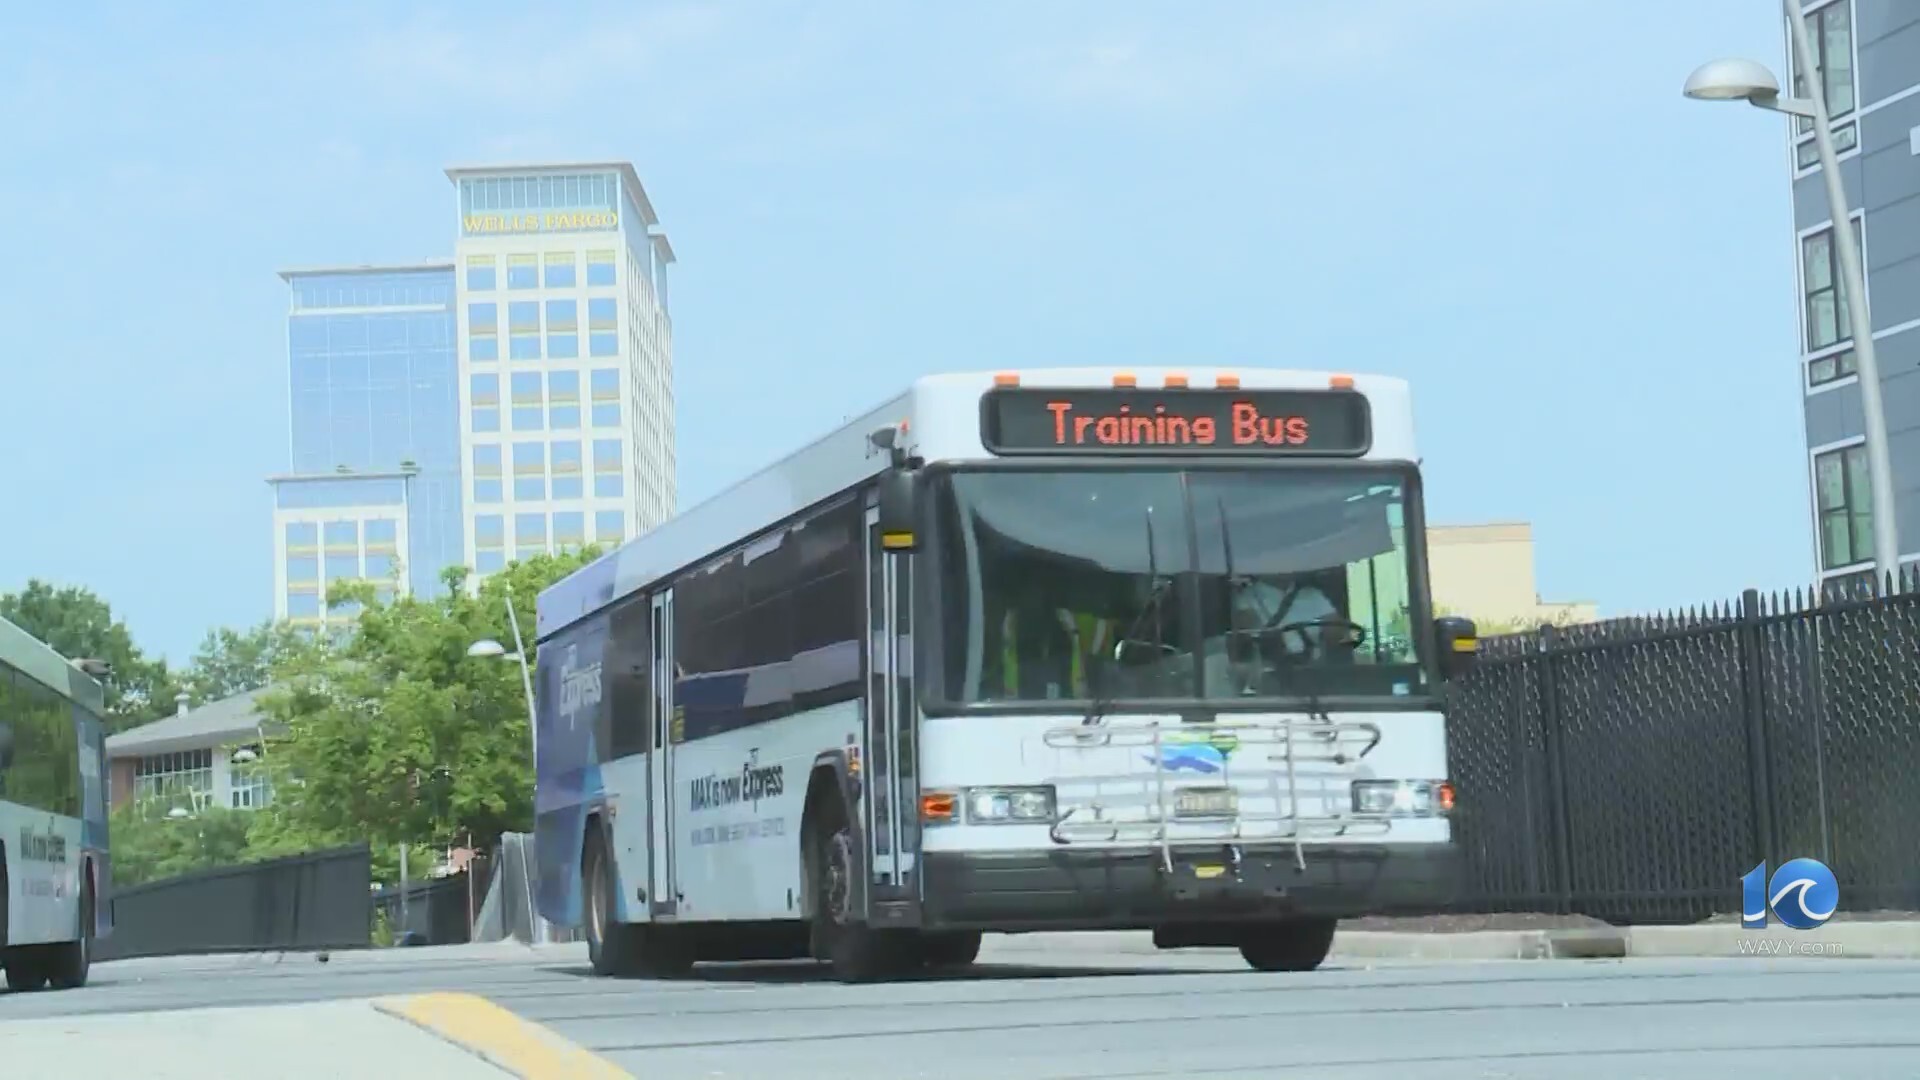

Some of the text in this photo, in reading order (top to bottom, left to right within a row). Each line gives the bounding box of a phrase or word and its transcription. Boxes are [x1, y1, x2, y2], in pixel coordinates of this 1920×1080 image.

[464, 210, 618, 232] WELLS FARGO
[1046, 401, 1309, 444] Training Bus
[690, 776, 712, 812] MAX
[742, 763, 784, 813] Express
